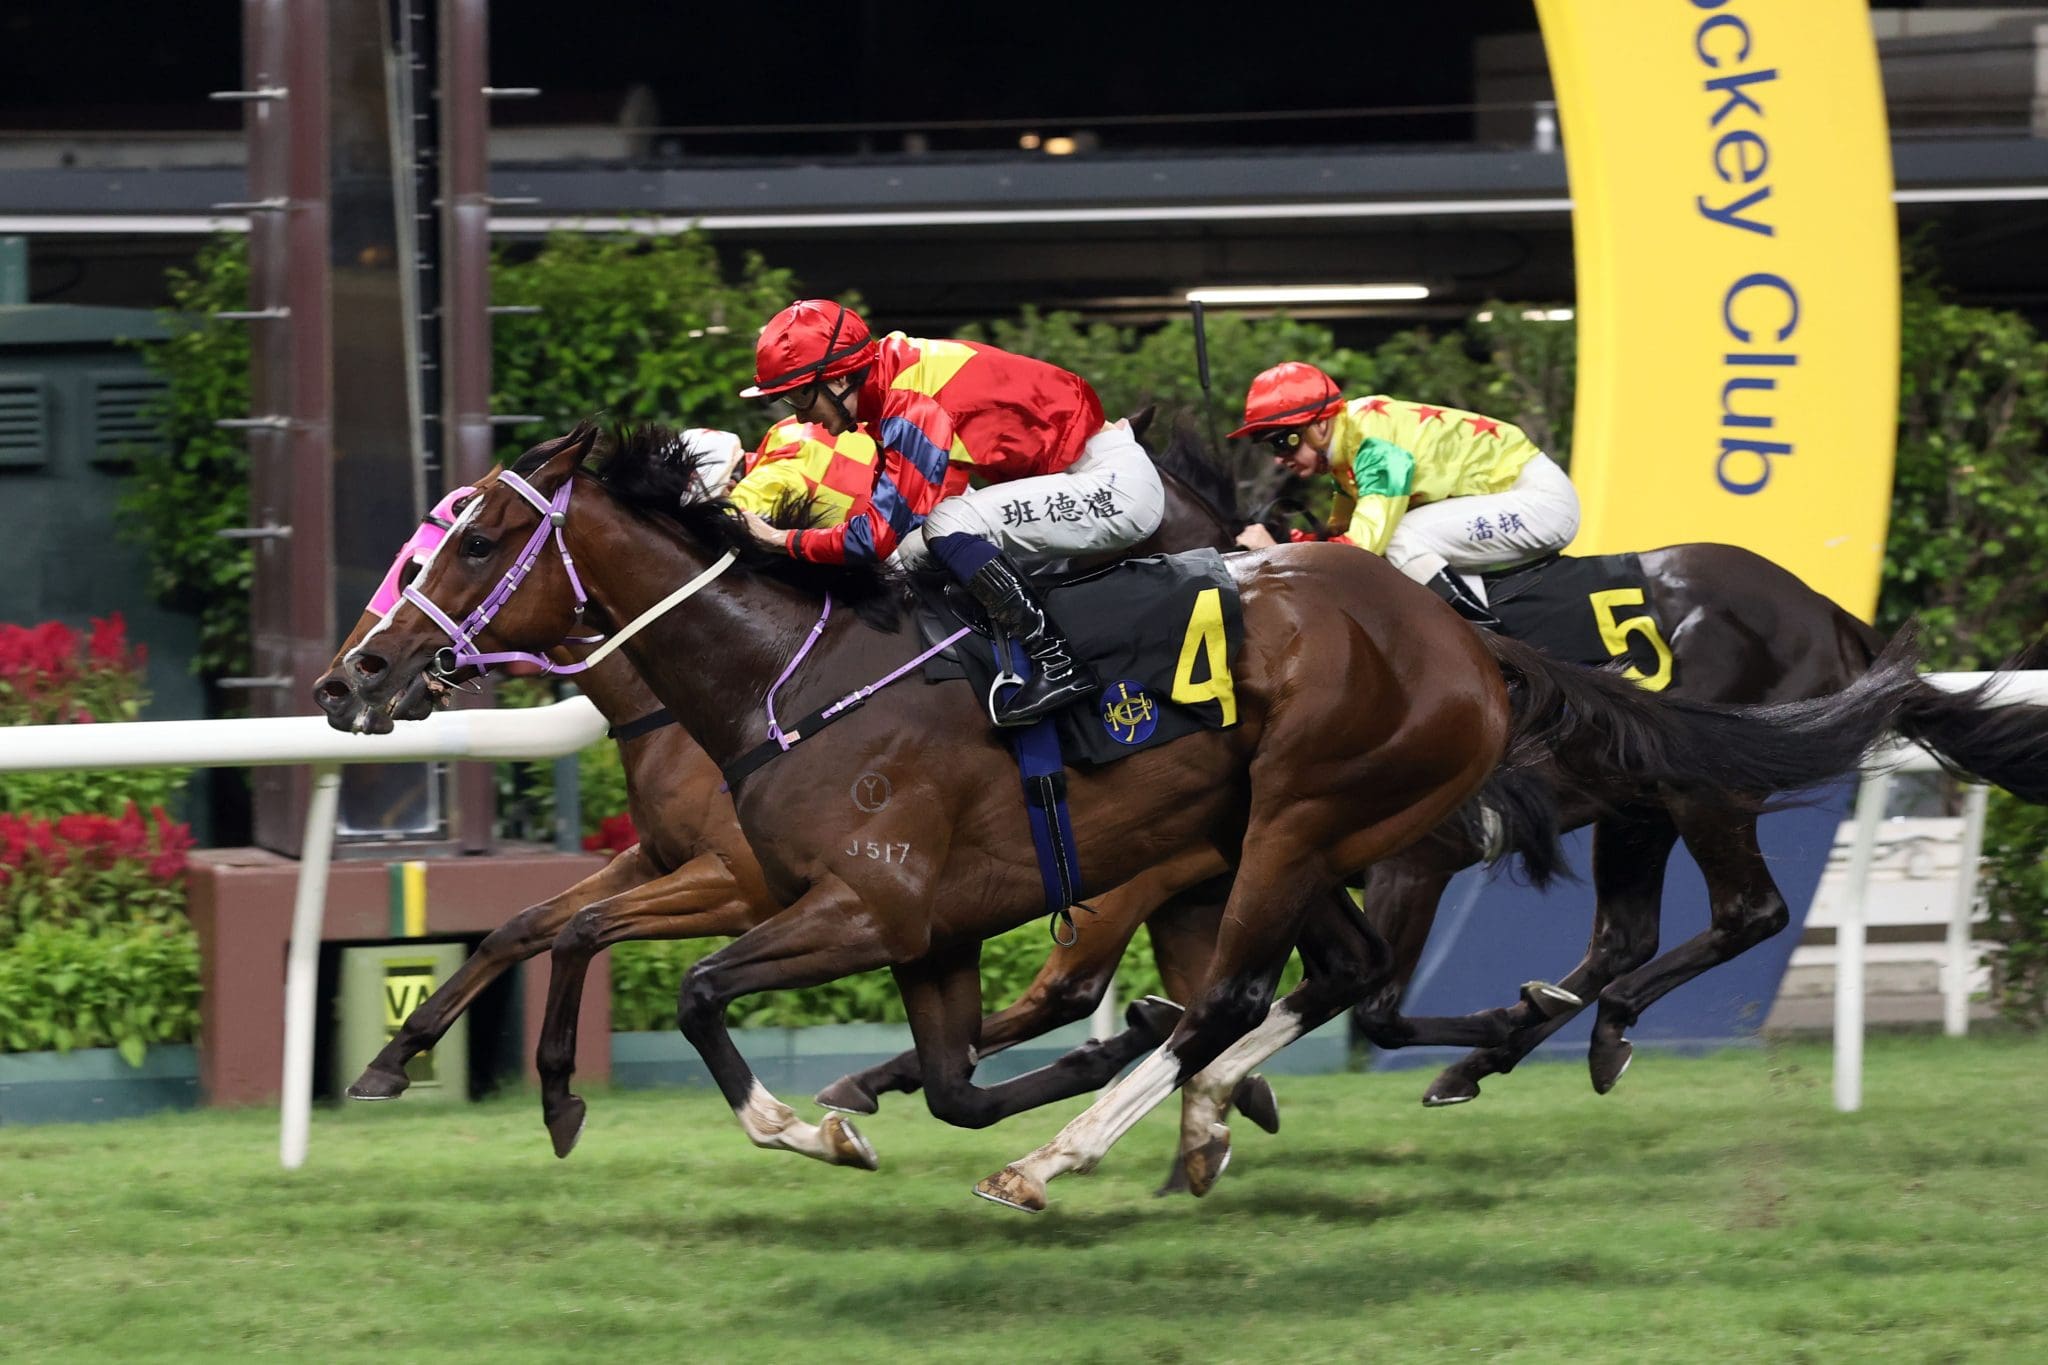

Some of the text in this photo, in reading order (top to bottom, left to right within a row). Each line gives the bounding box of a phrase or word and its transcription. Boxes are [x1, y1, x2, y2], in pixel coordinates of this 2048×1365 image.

[1690, 0, 1799, 495] ckey Club
[1001, 488, 1123, 527] 班德禮
[1466, 512, 1521, 541] 潘頓
[1171, 588, 1238, 727] 4
[1589, 587, 1673, 692] 5
